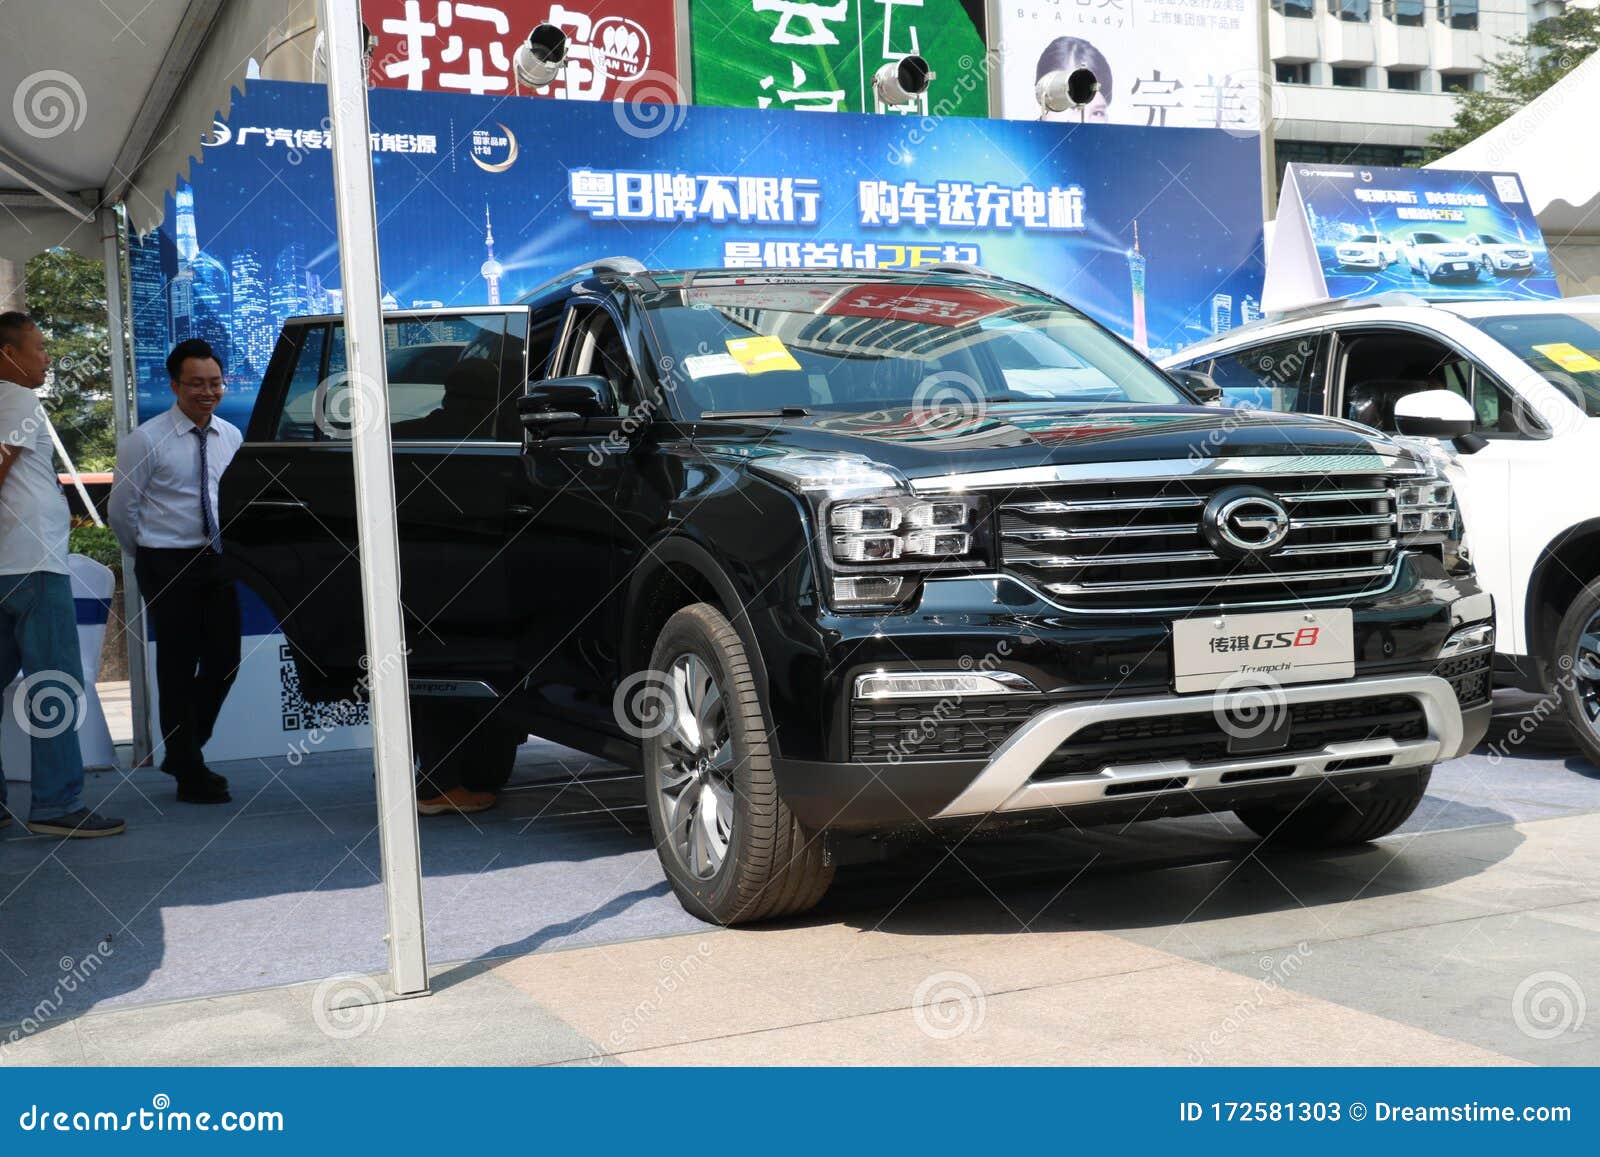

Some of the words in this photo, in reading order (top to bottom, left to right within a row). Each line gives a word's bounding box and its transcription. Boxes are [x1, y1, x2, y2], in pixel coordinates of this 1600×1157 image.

[571, 171, 820, 223] 粤B牌不限行
[859, 180, 1085, 229] 购车送充电桩
[1240, 662, 1291, 674] Trumpchi
